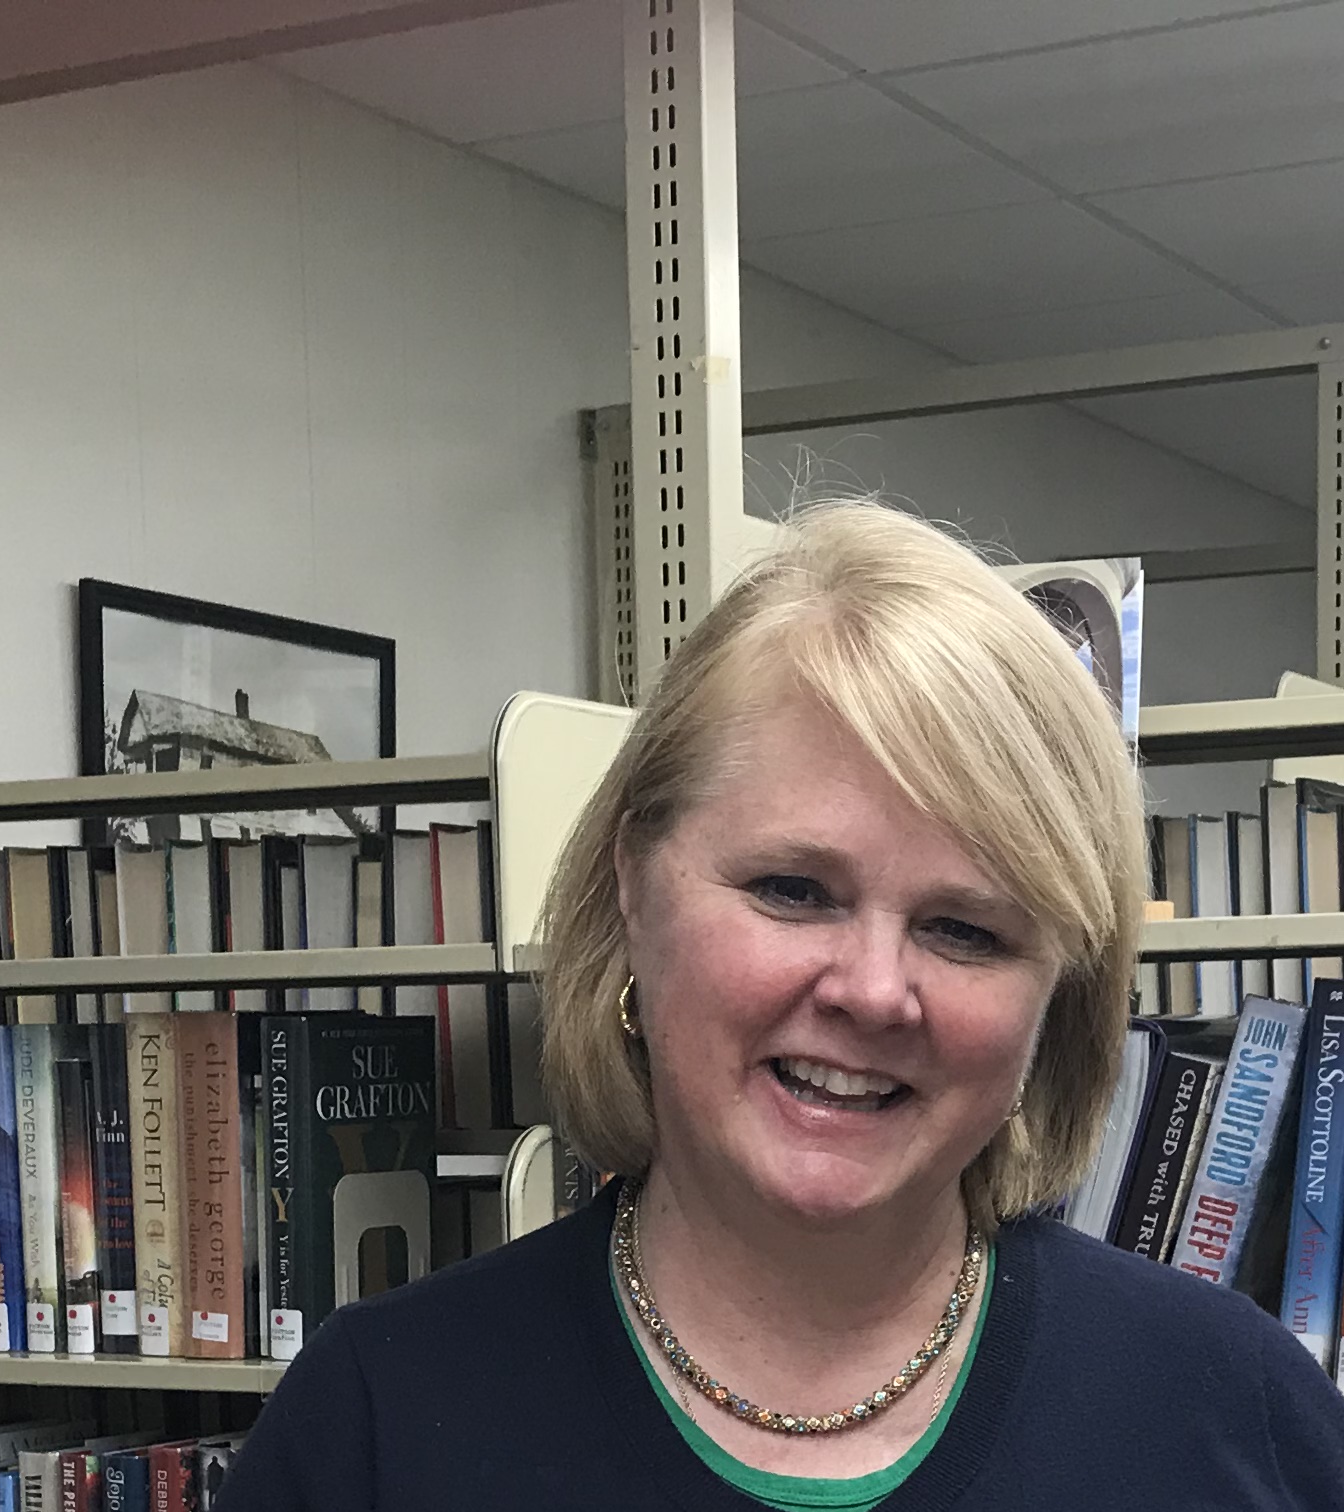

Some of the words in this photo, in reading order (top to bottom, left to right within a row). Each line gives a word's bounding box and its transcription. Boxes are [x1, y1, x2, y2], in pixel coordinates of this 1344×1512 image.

[139, 1034, 160, 1088] KEN
[270, 1030, 288, 1073] SUE
[352, 1045, 399, 1081] SUE
[1243, 1016, 1290, 1051] JOHN
[206, 1042, 229, 1185] elizabeth
[272, 1076, 290, 1179] GRAFTON
[316, 1081, 431, 1122] GRAFTON
[1162, 1069, 1197, 1157] CHASED
[1206, 1047, 1279, 1187] SANDFORD
[142, 1098, 166, 1211] FOLLETT
[1306, 1065, 1344, 1204] SCOTTOLINE
[270, 1187, 295, 1223] Y
[1147, 1160, 1169, 1205] with
[205, 1201, 225, 1300] george
[1187, 1195, 1239, 1262] DEEP
[63, 1462, 75, 1488] THE
